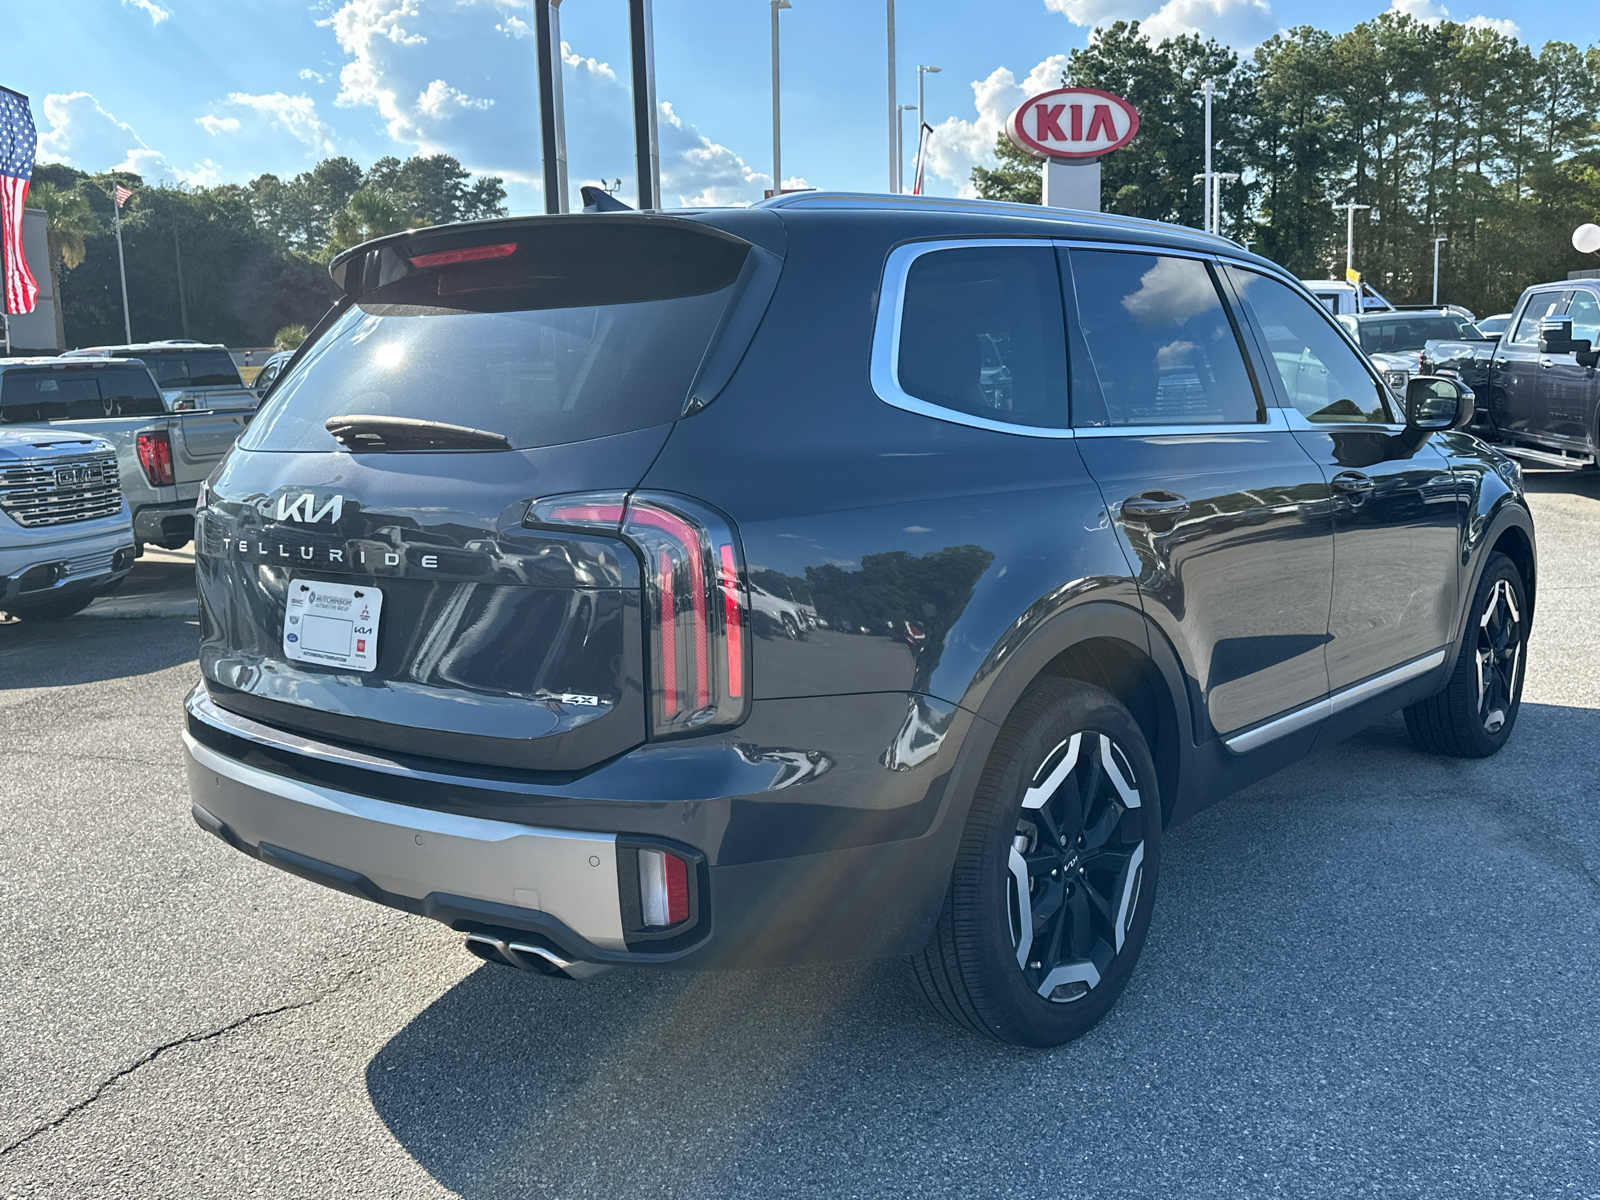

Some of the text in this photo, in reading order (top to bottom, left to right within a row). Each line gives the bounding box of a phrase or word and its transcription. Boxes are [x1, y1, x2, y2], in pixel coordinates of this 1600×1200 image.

[1035, 104, 1119, 141] KIA
[277, 493, 343, 524] KIA
[222, 538, 438, 568] TELLURIDE
[354, 626, 372, 635] KIA
